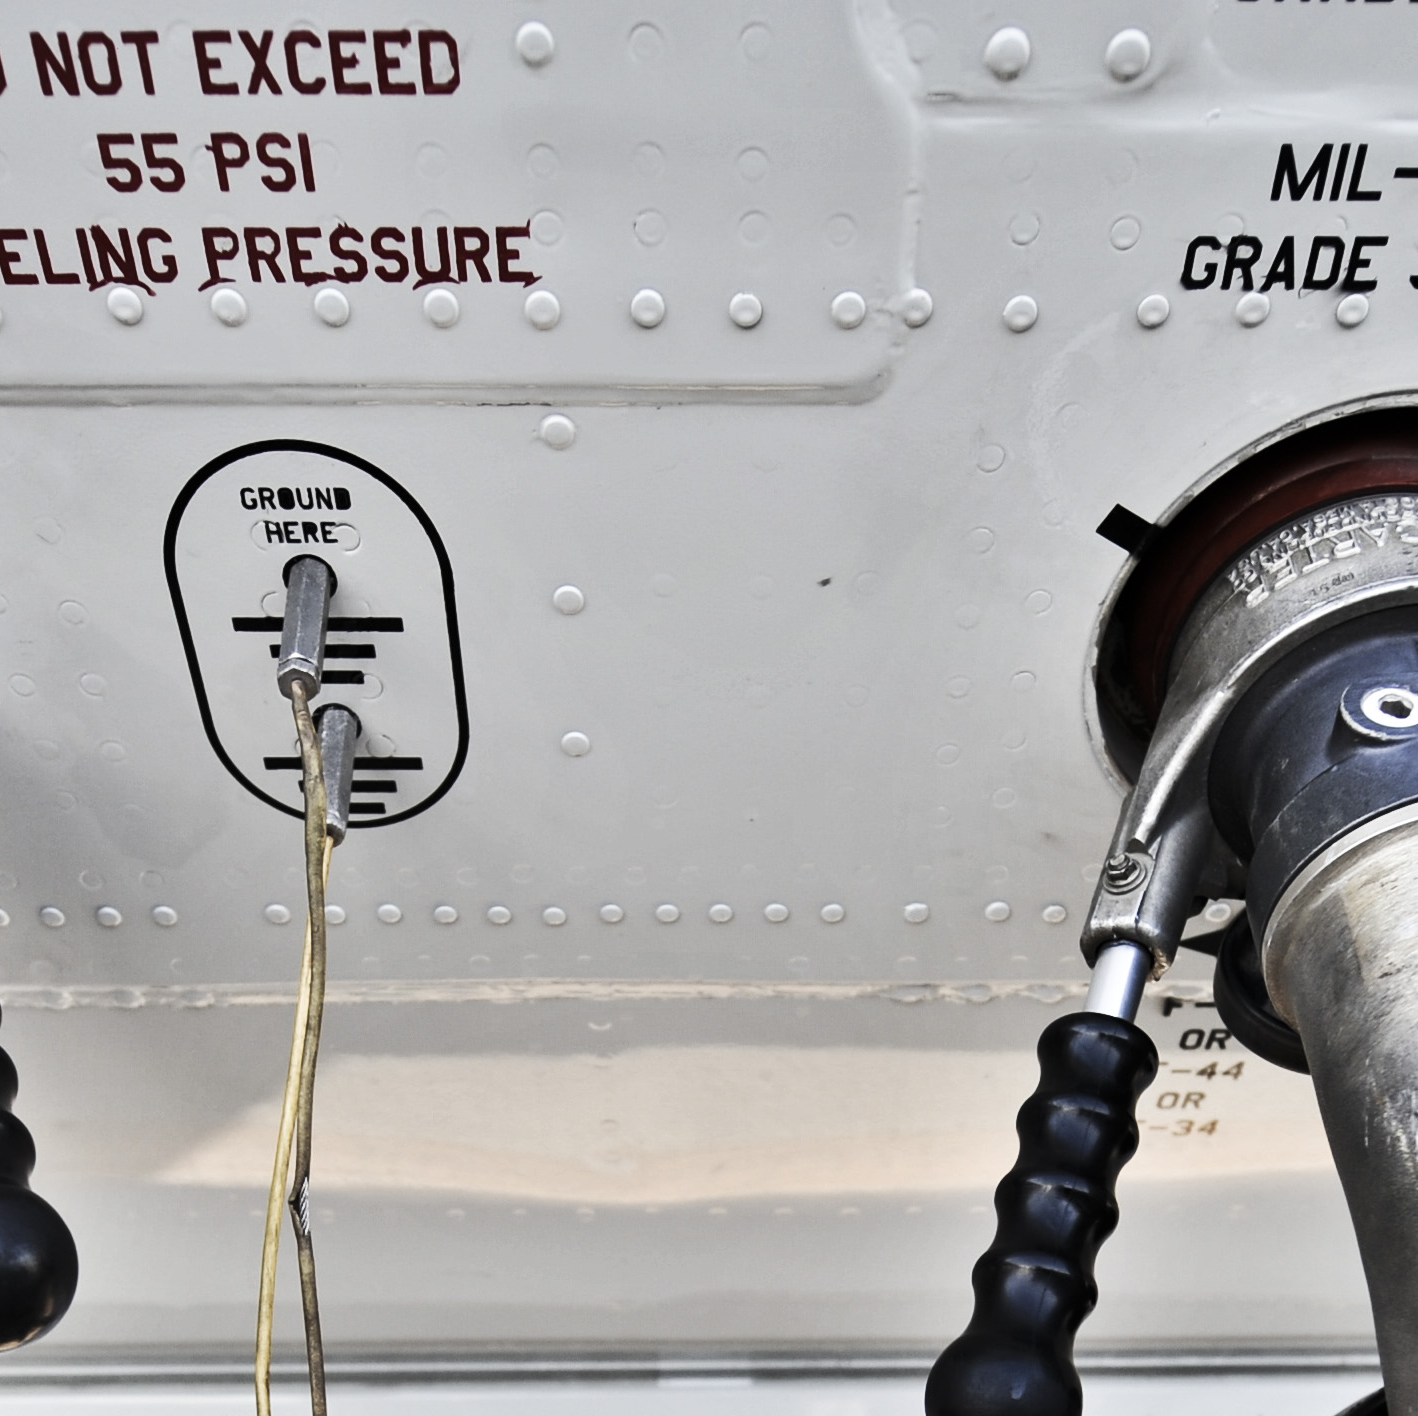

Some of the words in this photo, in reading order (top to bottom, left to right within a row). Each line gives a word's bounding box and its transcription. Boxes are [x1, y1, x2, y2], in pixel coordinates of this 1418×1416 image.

[30, 31, 158, 96] NOT
[193, 29, 460, 95] EXCEED
[96, 132, 185, 192] 55
[205, 132, 317, 192] PSI
[197, 219, 542, 291] PRESSURE
[1181, 235, 1389, 292] GRADE
[240, 487, 352, 510] GROUND
[265, 521, 338, 544] HERE
[1179, 1028, 1232, 1050] OR
[1159, 1061, 1245, 1080] -44
[1156, 1092, 1206, 1110] OR
